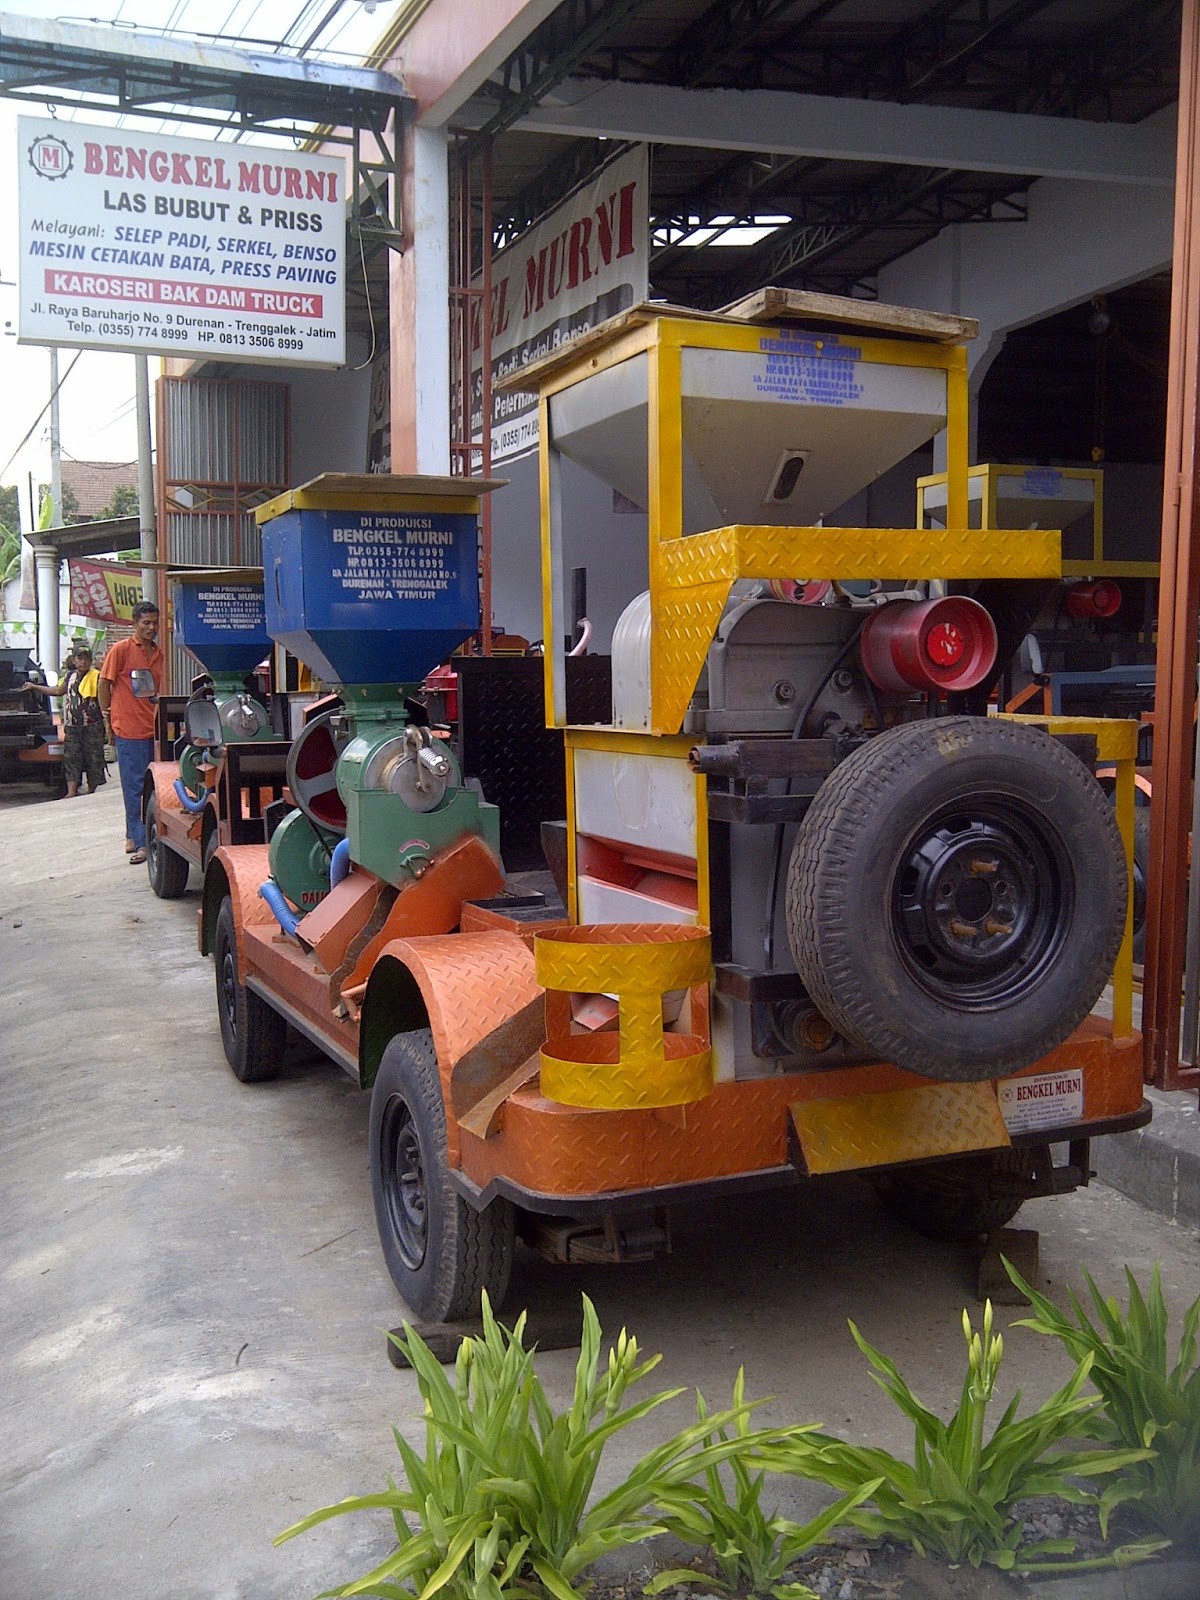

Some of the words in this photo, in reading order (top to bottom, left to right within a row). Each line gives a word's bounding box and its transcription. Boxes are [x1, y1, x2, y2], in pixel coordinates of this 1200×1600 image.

[42, 147, 60, 168] M
[84, 142, 231, 190] BENGKEL
[238, 161, 338, 202] MURNI
[104, 190, 146, 213] LAS
[155, 196, 230, 222] BUBUT
[237, 205, 252, 225] &
[261, 208, 323, 233] PRISS
[31, 218, 105, 239] Melayani:
[114, 226, 163, 244] SELEP
[168, 231, 211, 252] PADI,
[217, 236, 278, 259] SERKEL,
[283, 244, 337, 263] BENSO
[522, 181, 636, 319] MURNI
[29, 240, 86, 260] MESIN
[91, 247, 165, 268] CETAKAN
[170, 254, 215, 275] BATA,
[221, 260, 272, 278] PRESS
[276, 265, 337, 284] PAVING
[54, 273, 154, 299] KAROSERI
[160, 283, 200, 303] BAK
[205, 288, 246, 308] DAM
[250, 292, 315, 314] TRUCK
[30, 302, 45, 314] Jl.
[48, 304, 78, 319] Raya
[82, 306, 140, 324] Baruharjo
[143, 312, 163, 324] No.
[166, 314, 173, 325] 9
[176, 315, 224, 329] Durenan
[235, 319, 297, 336] Trenggalek
[306, 326, 336, 339] Jatim
[67, 320, 95, 334] Telp.
[98, 323, 134, 338] (0355)
[138, 326, 158, 338] 774
[161, 328, 188, 341] 8999
[198, 331, 216, 343] HP.
[219, 333, 246, 345] 0813
[249, 335, 275, 347] 3506
[278, 338, 304, 350] 8999
[360, 517, 372, 527] DI
[375, 517, 432, 529] PRODUKSI
[333, 529, 402, 544] BENGKEL
[406, 531, 453, 545] MURNI
[419, 547, 444, 557] 8999
[344, 568, 368, 578] JALAN
[371, 569, 391, 578] RAYA
[419, 559, 444, 568] 8999
[342, 579, 384, 588] DURENAN
[391, 580, 448, 590] TRENGGALEK
[358, 590, 393, 599] JAWA
[396, 590, 436, 600] TIMUR
[198, 592, 236, 600] BENGKEL
[1017, 1082, 1054, 1101] BENGKEL
[1055, 1078, 1081, 1096] MURNI
